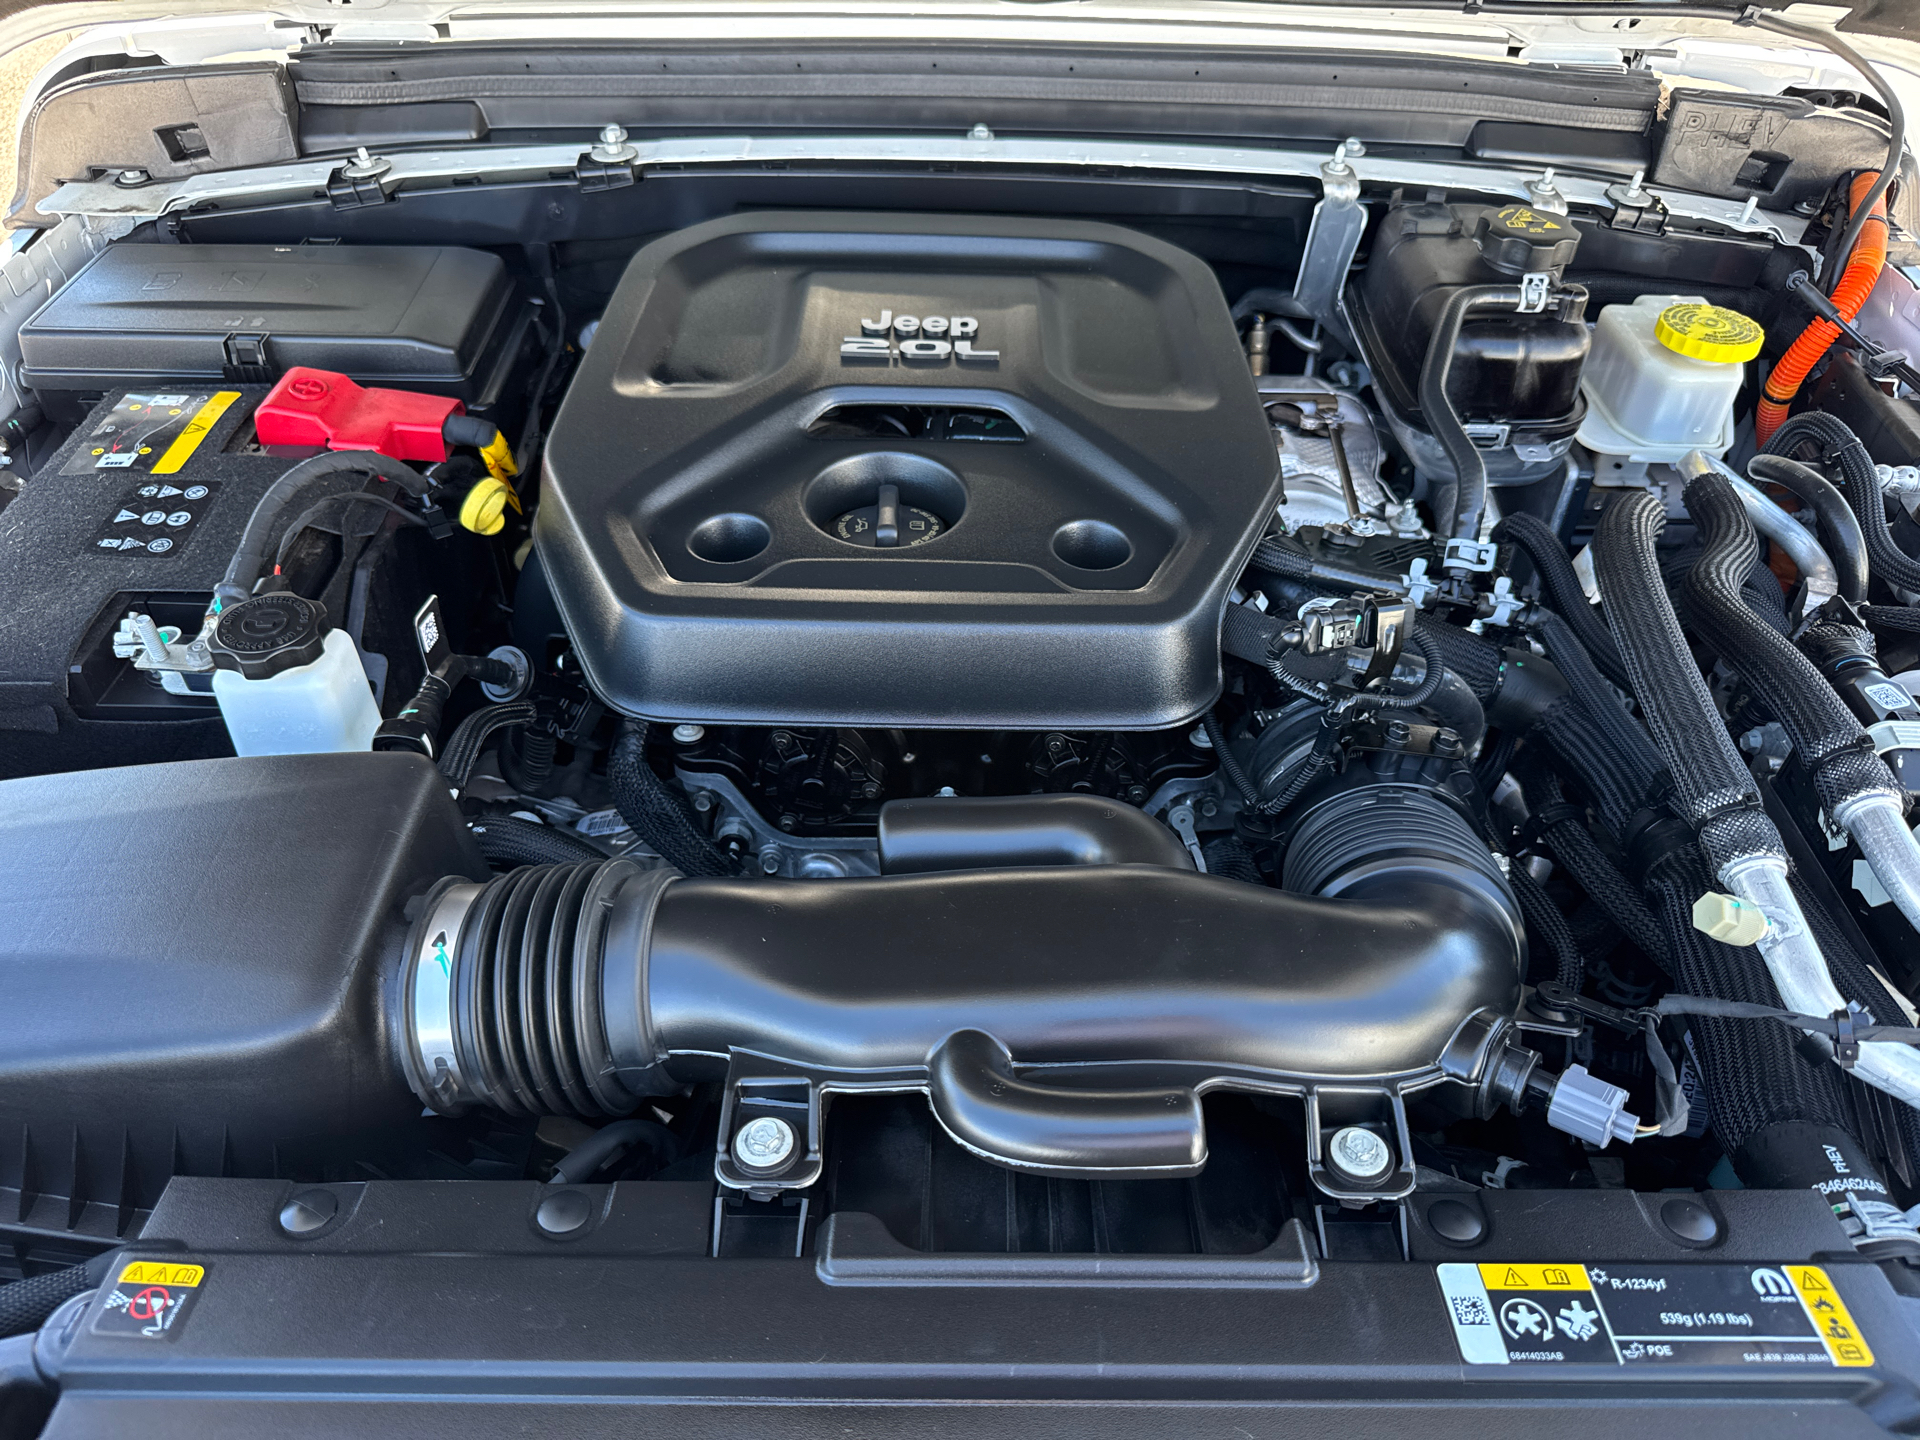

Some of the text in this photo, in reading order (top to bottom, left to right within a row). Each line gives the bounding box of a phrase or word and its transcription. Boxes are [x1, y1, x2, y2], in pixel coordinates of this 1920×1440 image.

[1675, 110, 1791, 150] PHEV
[860, 309, 979, 337] Jeep
[840, 336, 1000, 362] 2.0L
[837, 514, 854, 539] ENGINE OIL
[244, 596, 296, 609] STEERING
[222, 605, 245, 625] FLUID
[222, 633, 273, 651] APPROVED
[1822, 1144, 1851, 1174] PHEV
[1610, 1278, 1667, 1293] R-1234yf
[1659, 1312, 1753, 1328] 539g (1.19 lbs)
[1509, 1351, 1565, 1361] 68414033AB
[1646, 1344, 1674, 1357] POE
[1742, 1353, 1762, 1363] SAE
